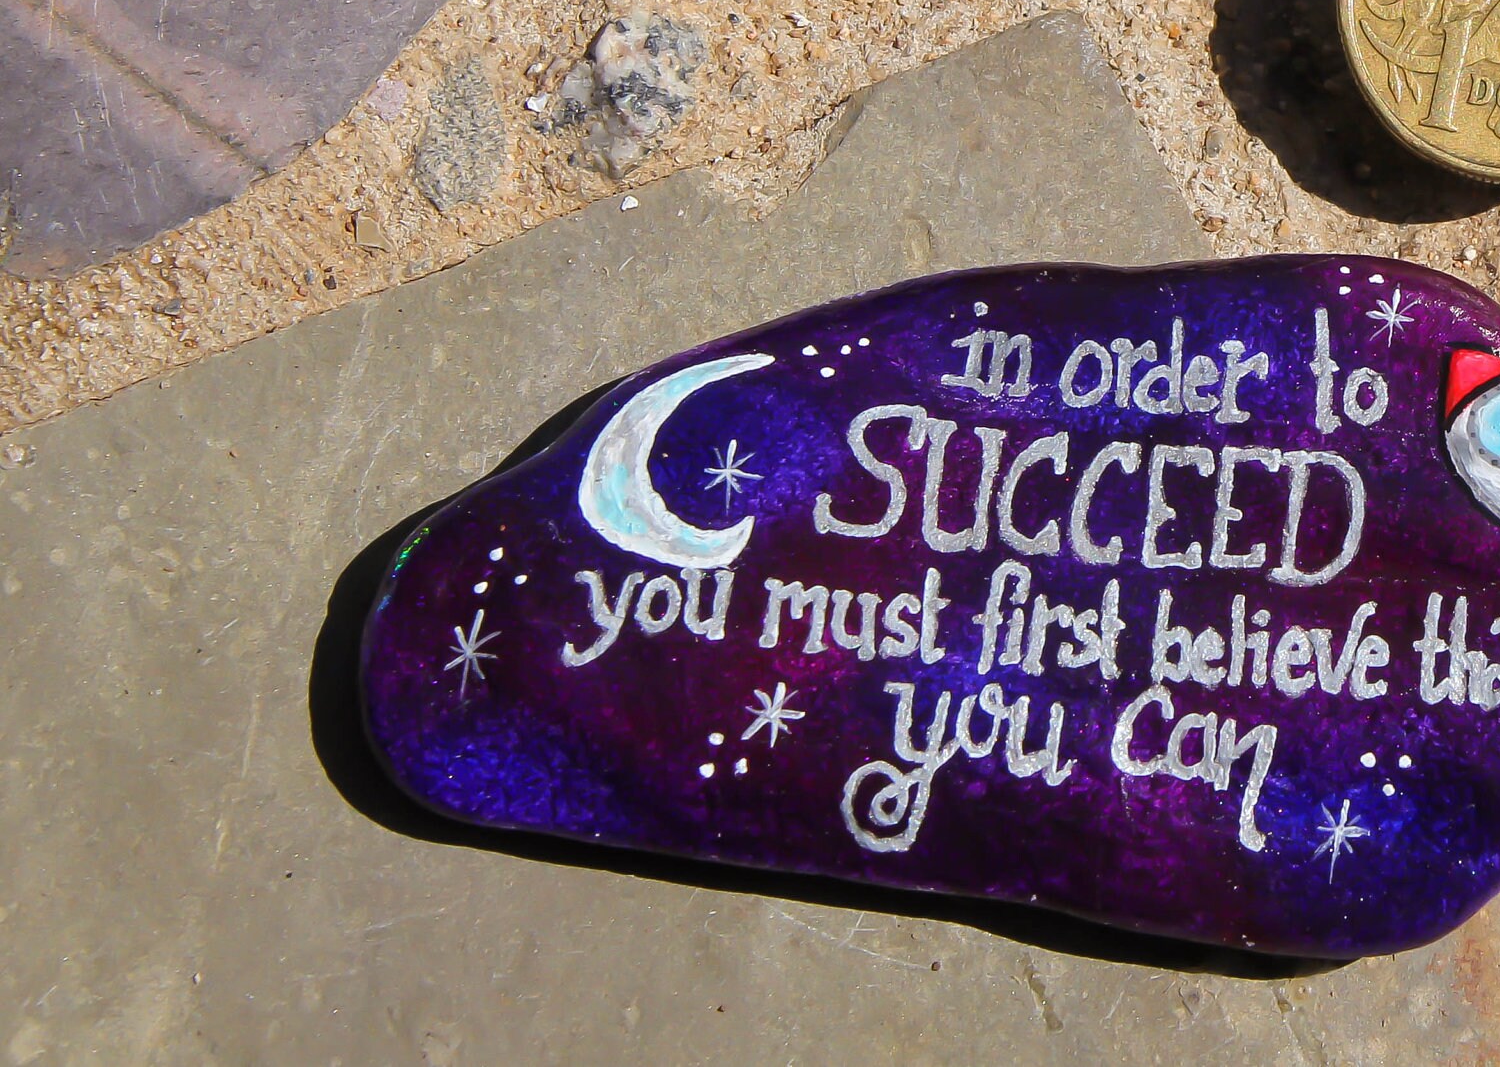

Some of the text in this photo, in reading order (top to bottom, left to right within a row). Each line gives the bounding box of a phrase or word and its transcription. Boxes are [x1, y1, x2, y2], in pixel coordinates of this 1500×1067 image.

[942, 302, 1388, 434] in order to
[814, 404, 1367, 587] SUCCEED
[561, 567, 733, 668] you
[762, 567, 945, 665] must
[974, 561, 1126, 677] first
[1152, 589, 1391, 699] believe
[840, 682, 1074, 855] you
